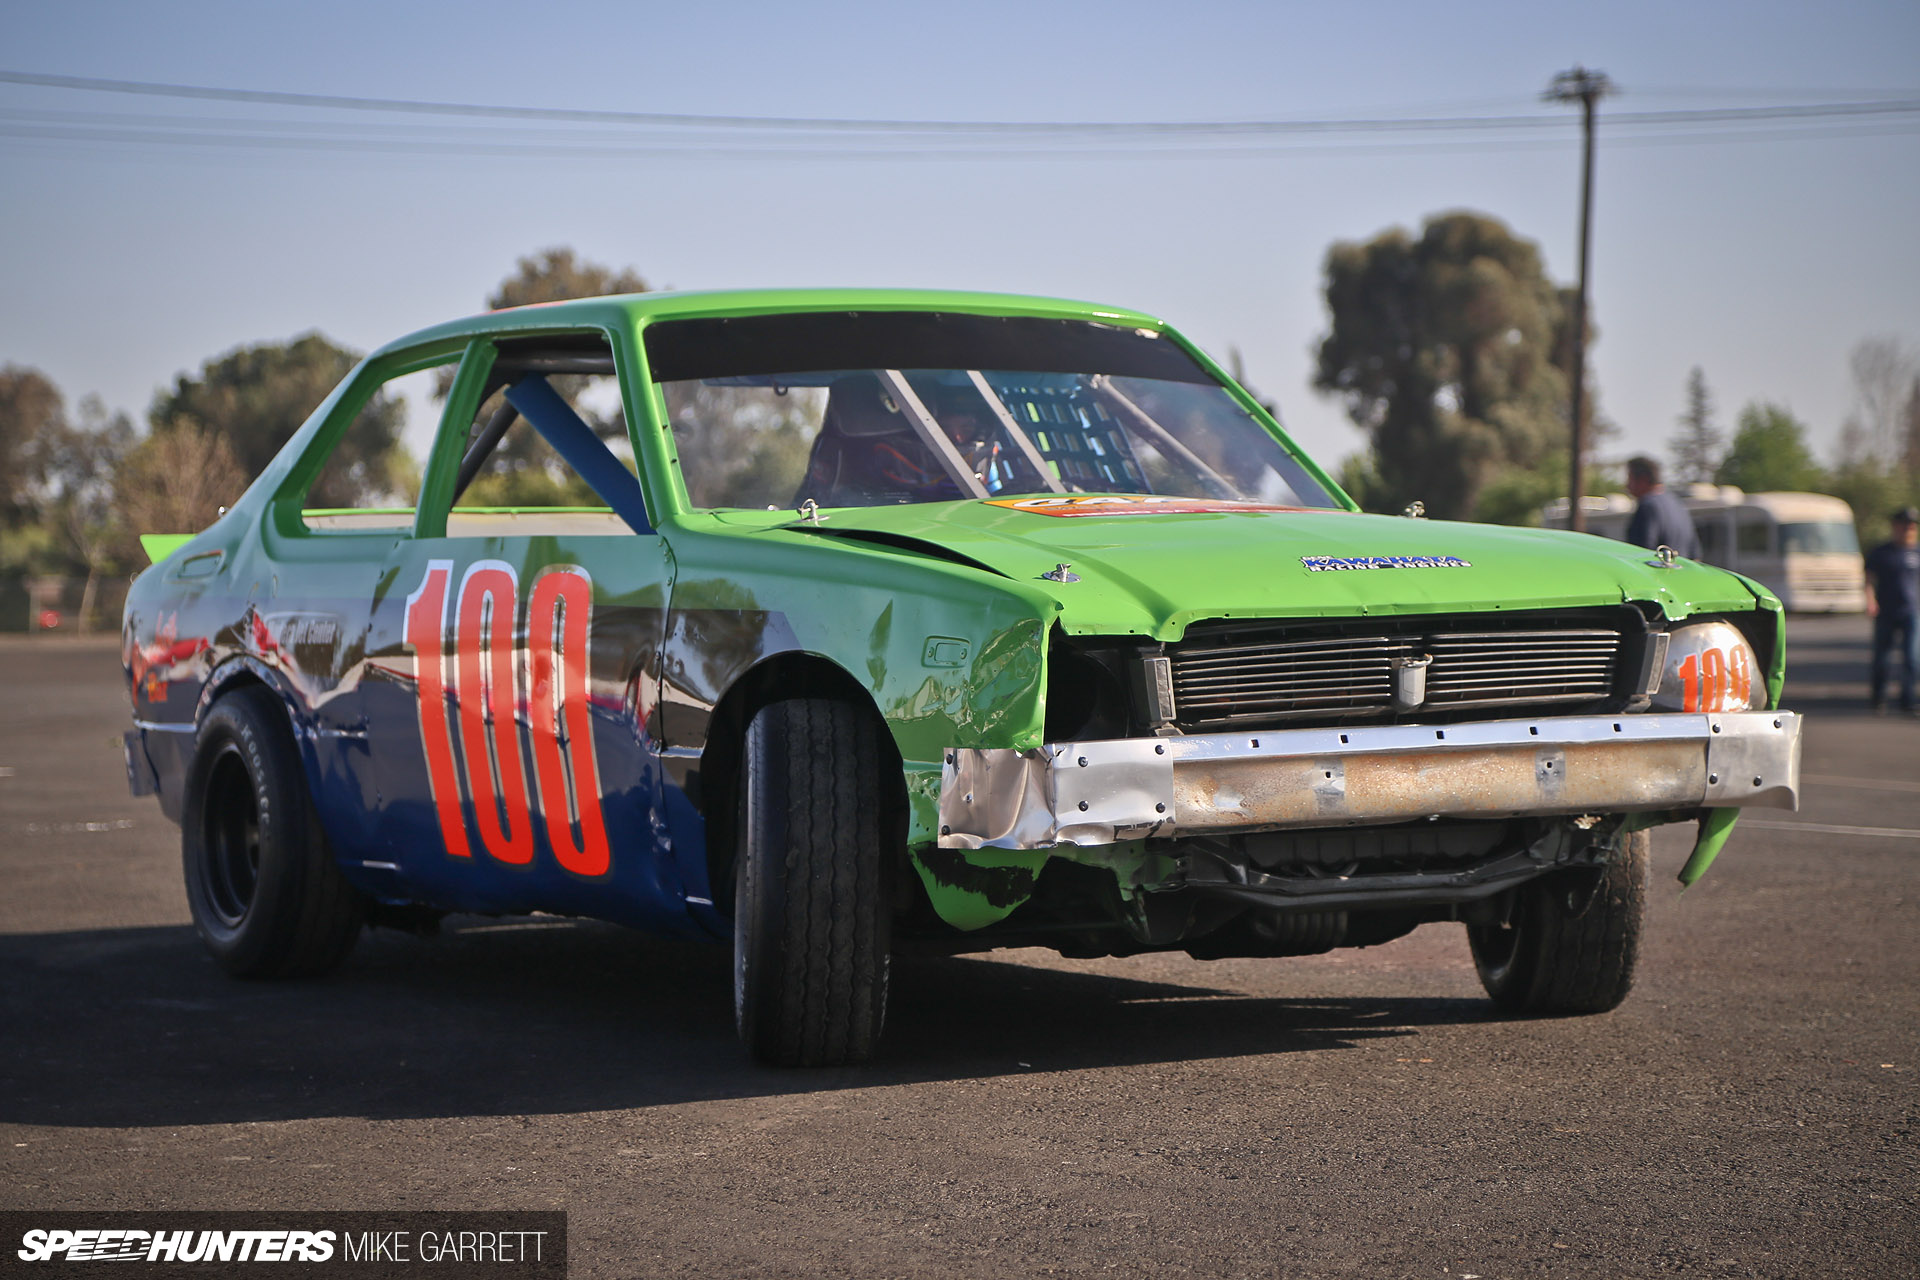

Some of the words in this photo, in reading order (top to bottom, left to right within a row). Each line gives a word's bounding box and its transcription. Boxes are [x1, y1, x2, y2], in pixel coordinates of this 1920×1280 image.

[1309, 563, 1379, 572] RACING
[1679, 643, 1752, 713] 100
[402, 559, 611, 878] 100
